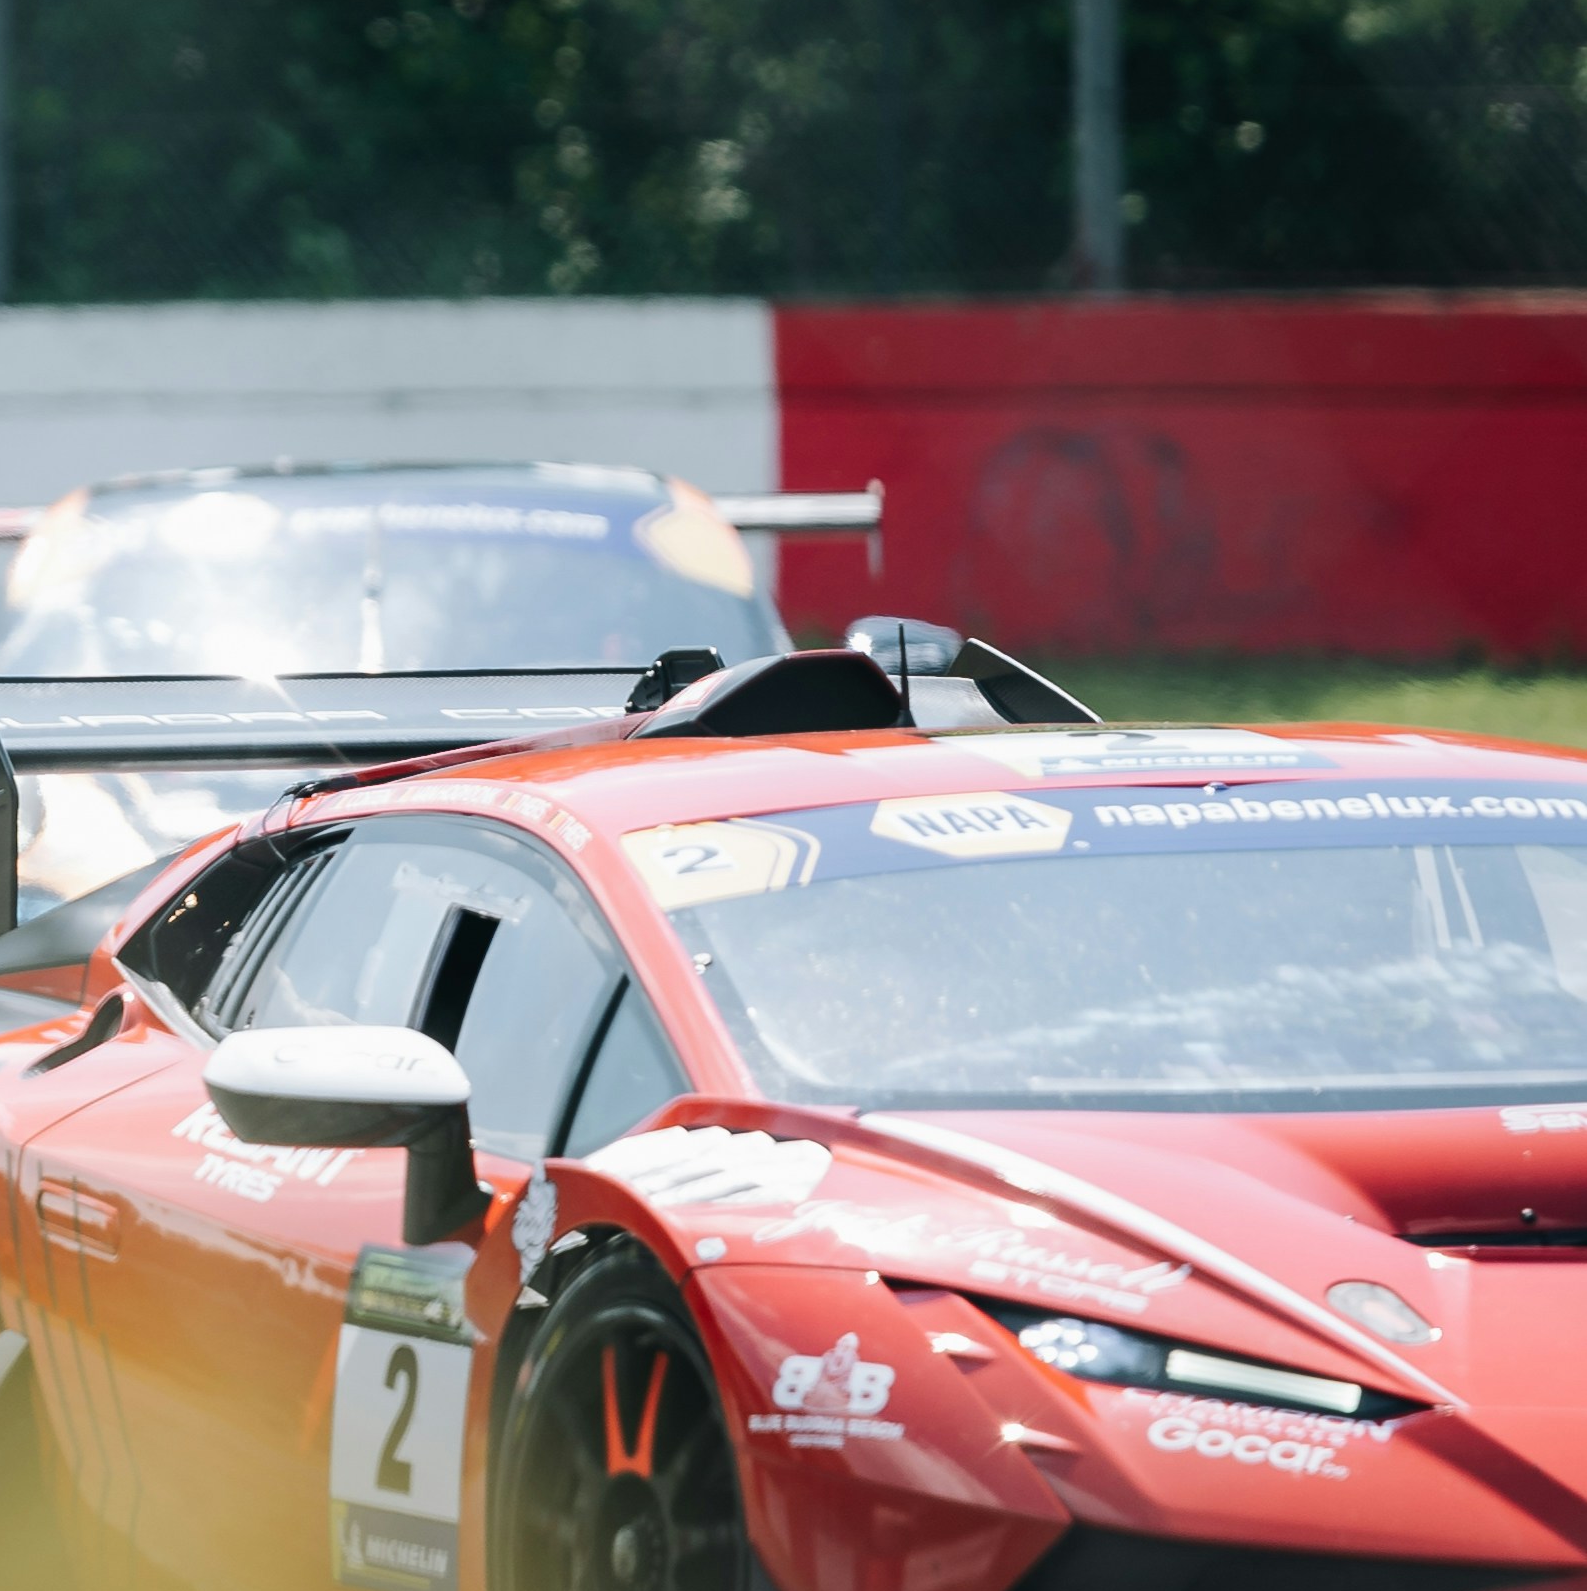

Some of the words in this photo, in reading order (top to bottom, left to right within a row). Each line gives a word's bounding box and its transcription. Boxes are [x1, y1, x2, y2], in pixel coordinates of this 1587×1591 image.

[1067, 731, 1190, 751] 2
[1100, 754, 1300, 768] MICHELIN
[897, 803, 1052, 839] NAPA
[1093, 792, 1587, 830] napabenelux.com
[661, 843, 737, 876] 2
[193, 1152, 284, 1204] TYRES
[375, 1342, 421, 1497] 2
[365, 1533, 449, 1576] MICHELIN
